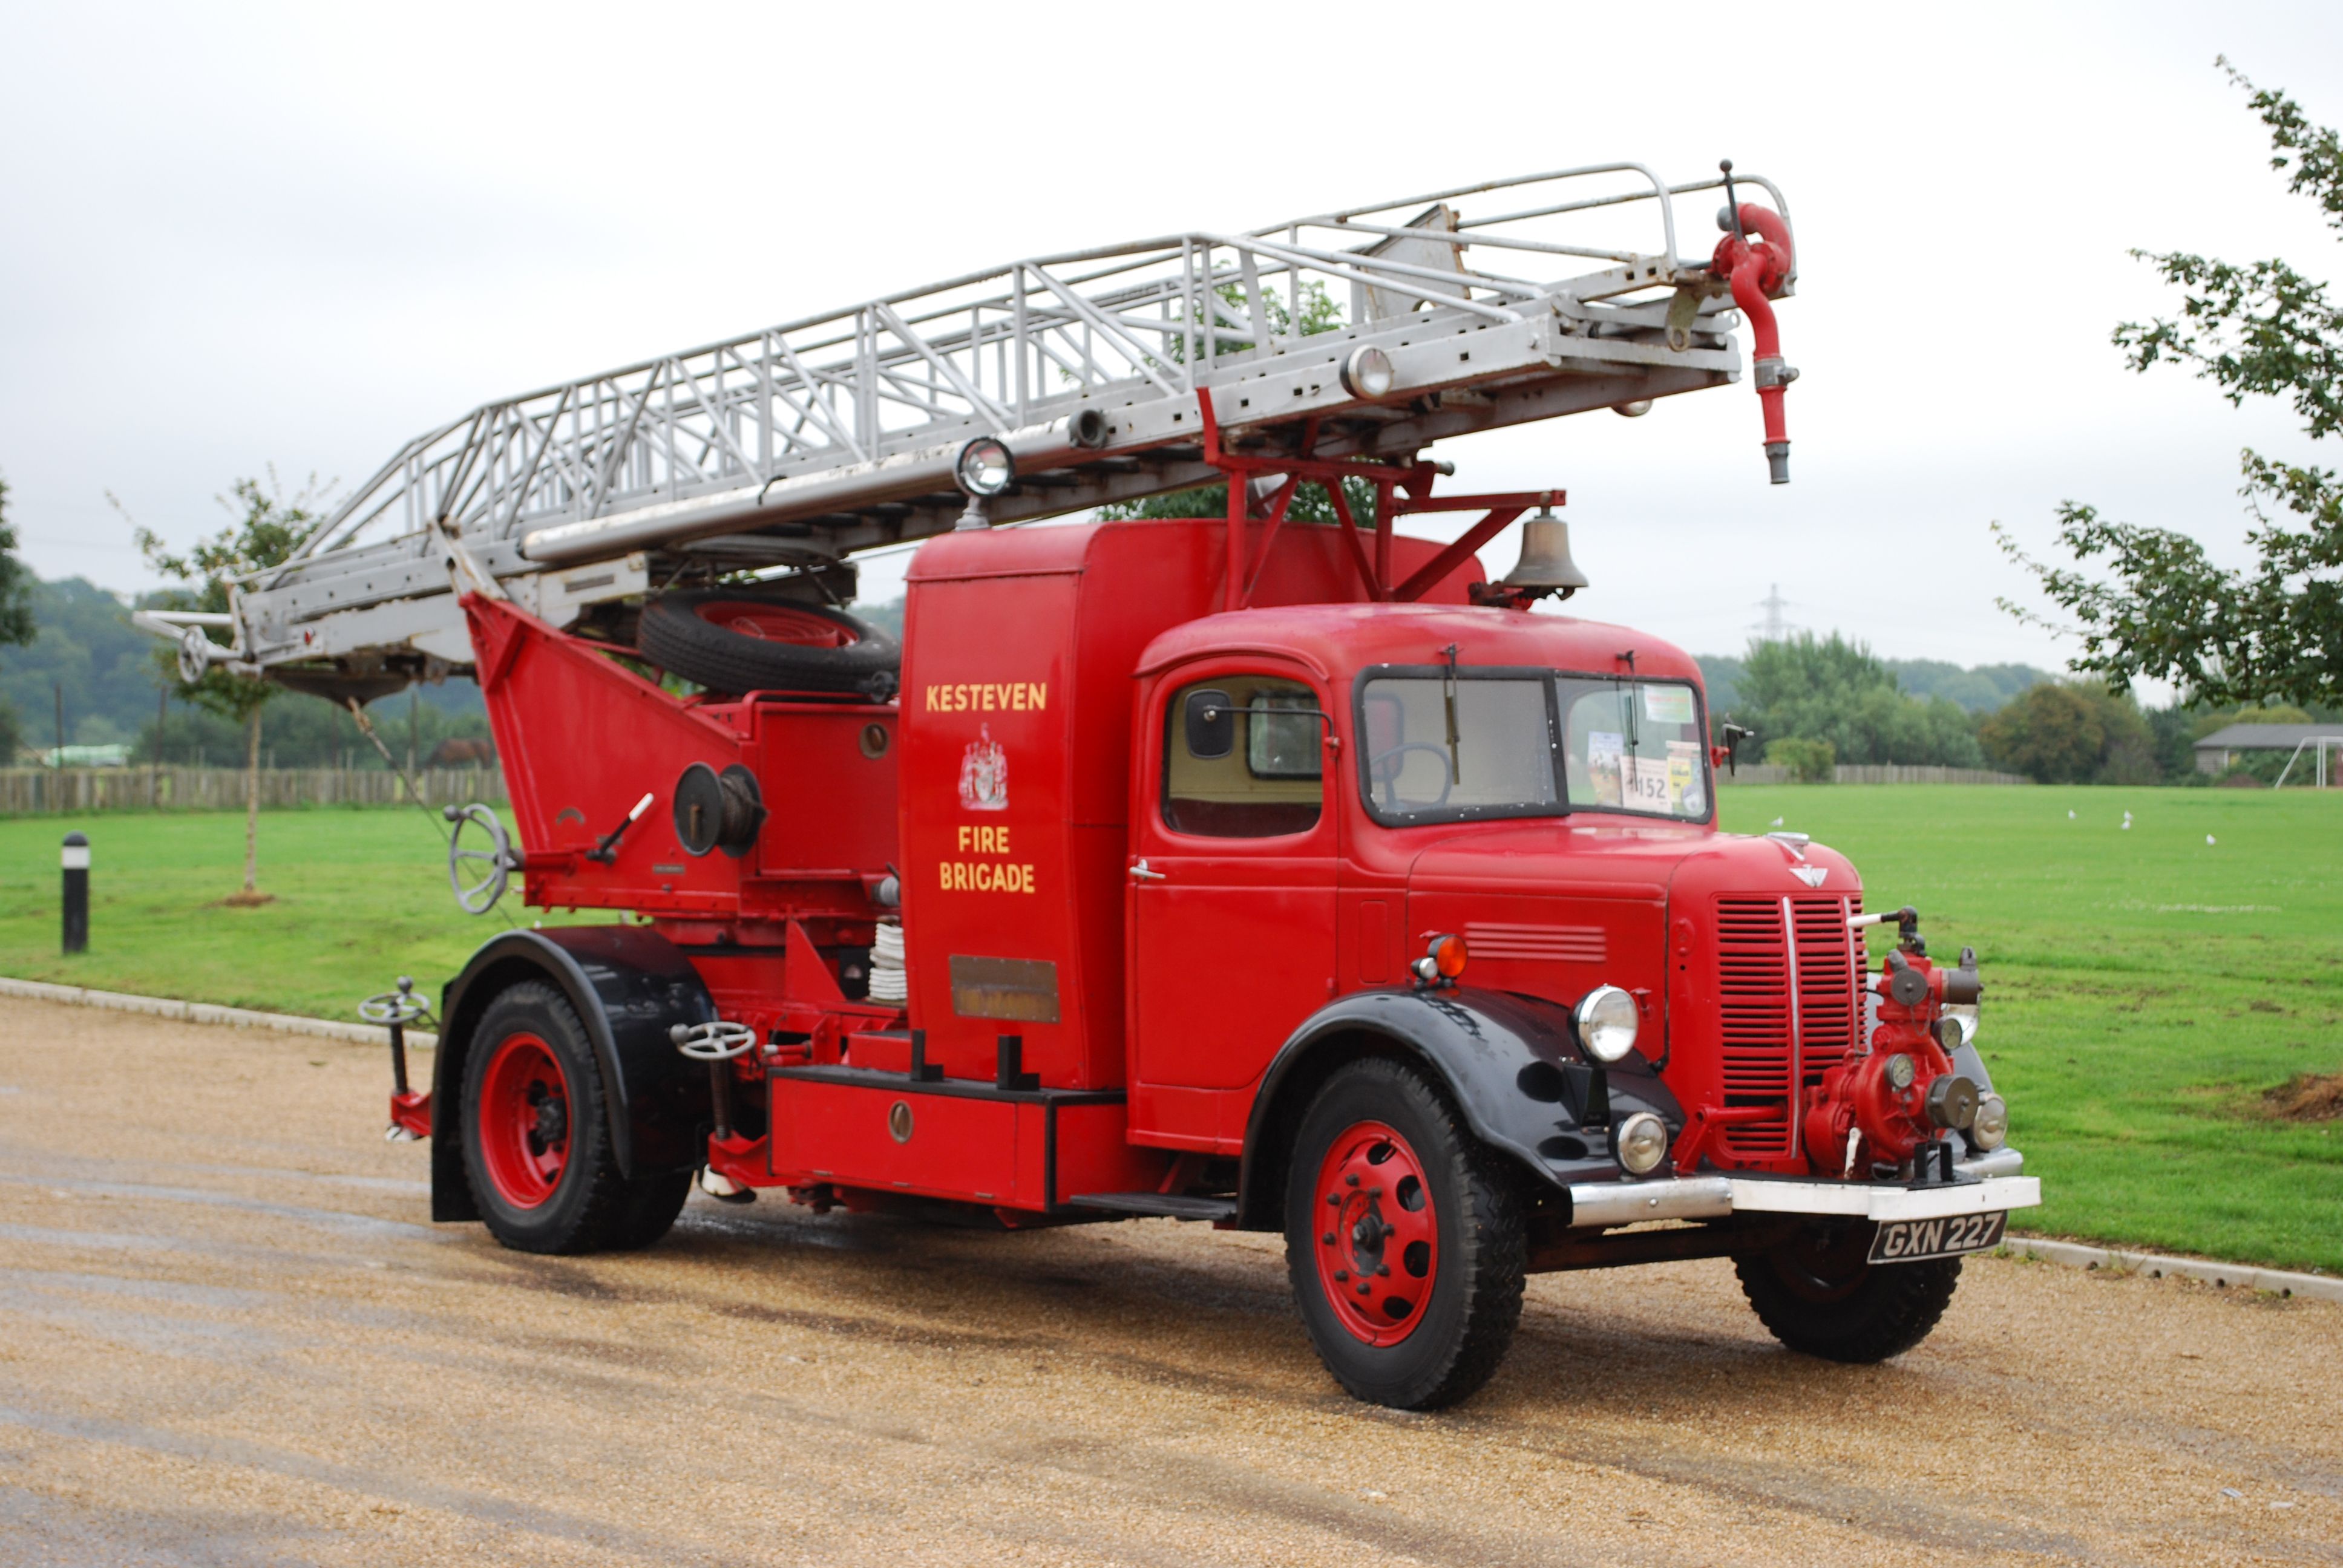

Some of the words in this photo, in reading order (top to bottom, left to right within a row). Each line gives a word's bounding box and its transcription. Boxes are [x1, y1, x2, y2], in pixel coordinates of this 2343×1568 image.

[926, 682, 1046, 711] KESTEVEN
[1638, 777, 1666, 799] 152
[959, 826, 1009, 853] FIRE
[940, 862, 1034, 893] BRIGADE
[1884, 1220, 1945, 1256] GXN
[1944, 1212, 2003, 1250] 227
